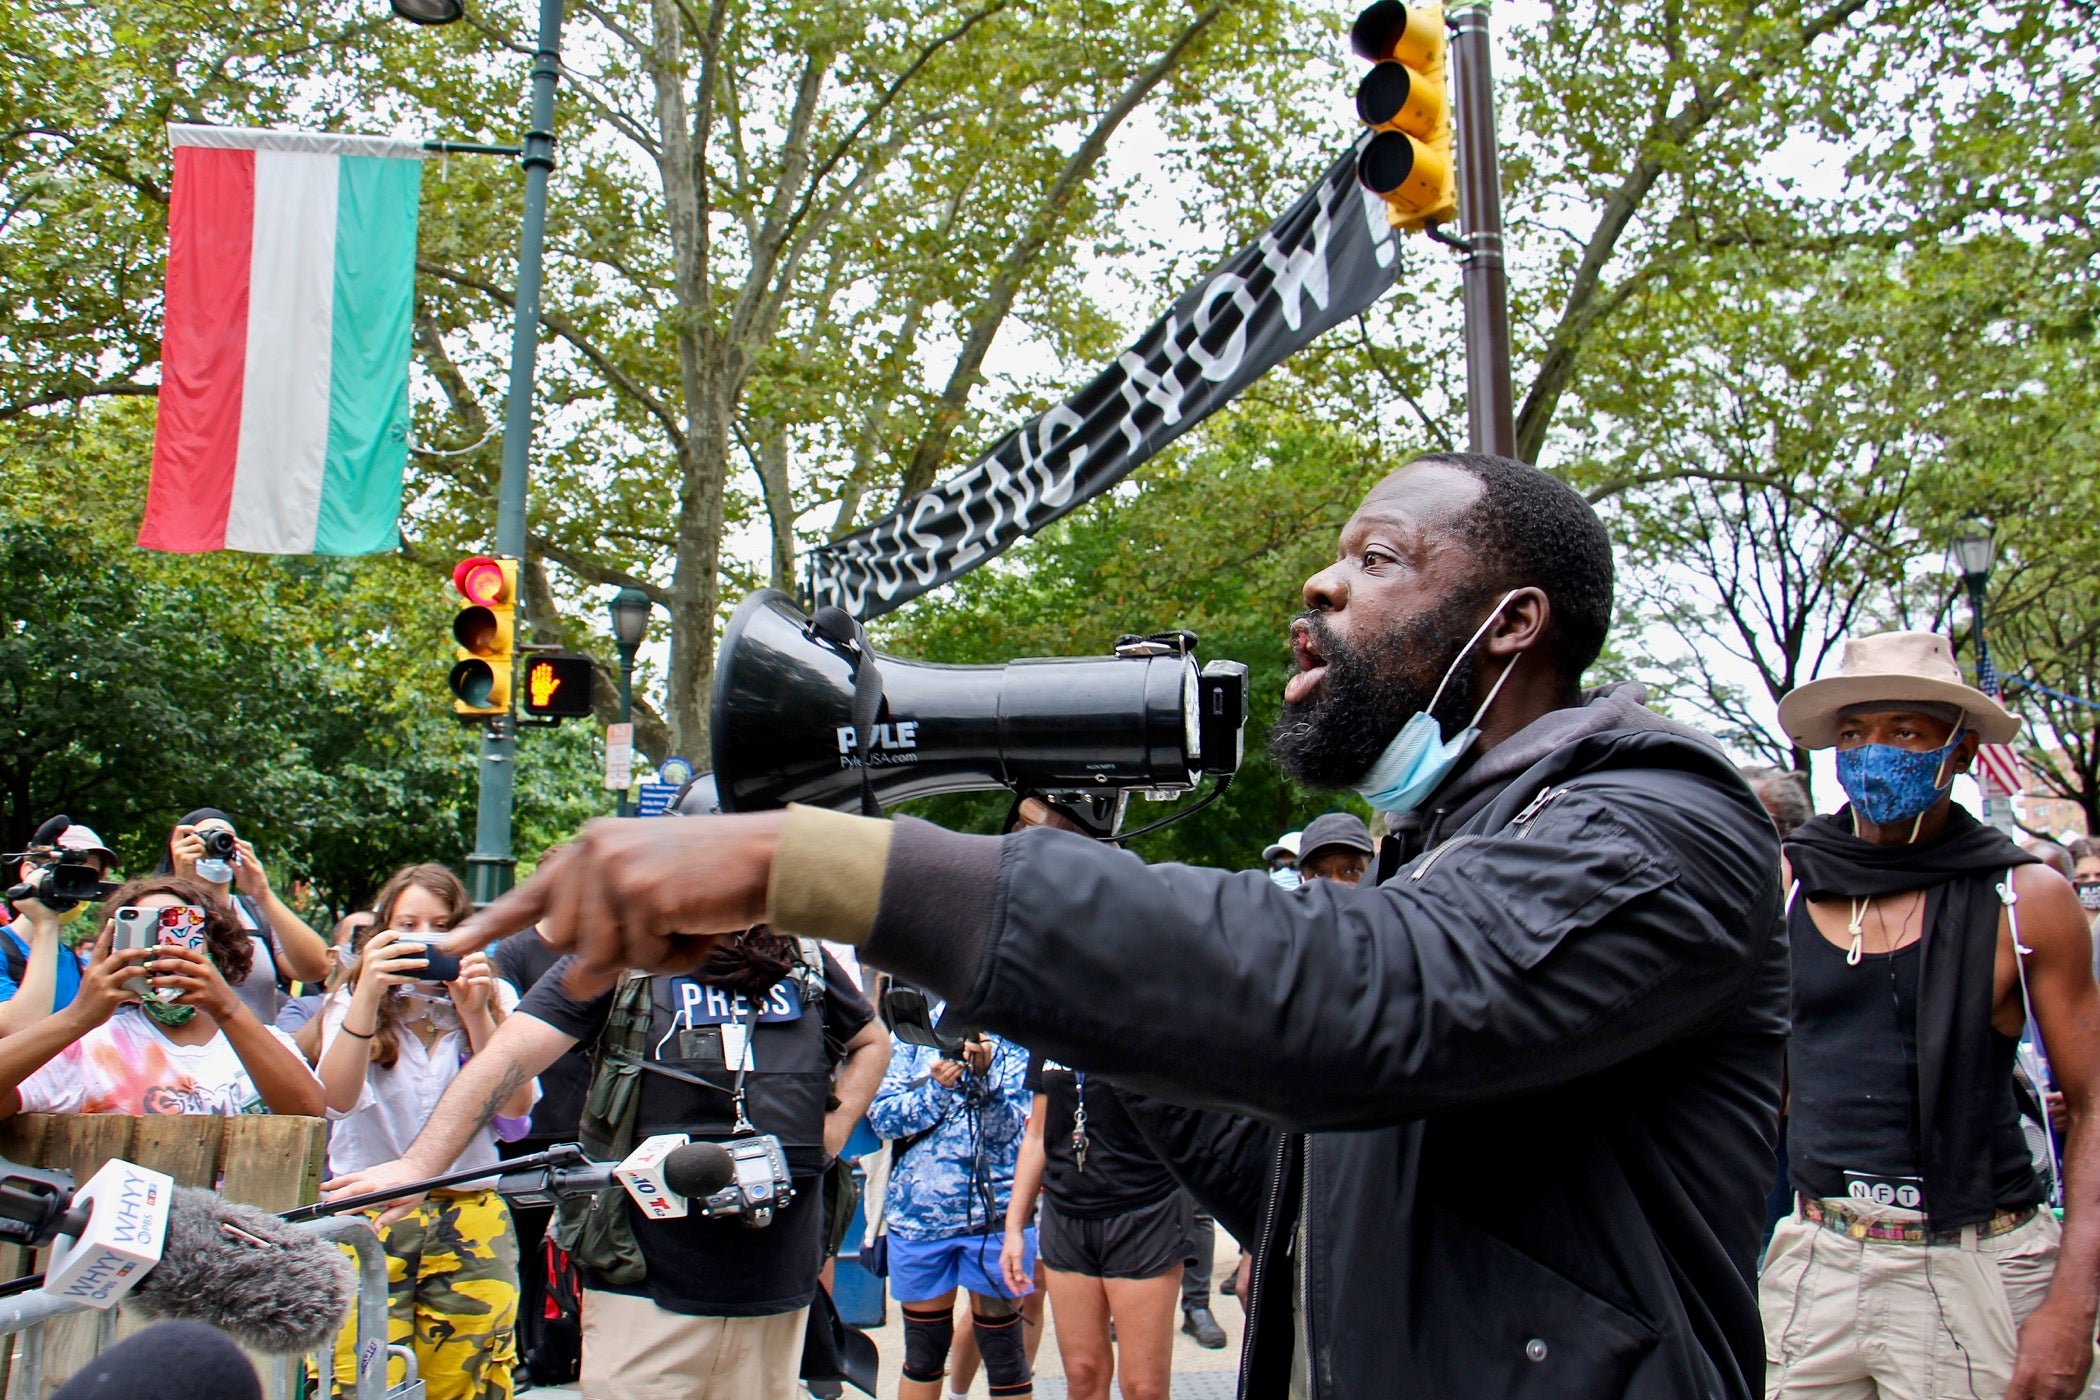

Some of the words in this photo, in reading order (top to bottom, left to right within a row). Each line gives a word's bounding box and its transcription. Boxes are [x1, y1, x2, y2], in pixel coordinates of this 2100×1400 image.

[812, 404, 1087, 617] HOUSING
[113, 1170, 145, 1242] WHYY
[634, 1178, 656, 1194] 10
[1852, 1183, 1917, 1205] NFT
[63, 1251, 125, 1297] WHYY
